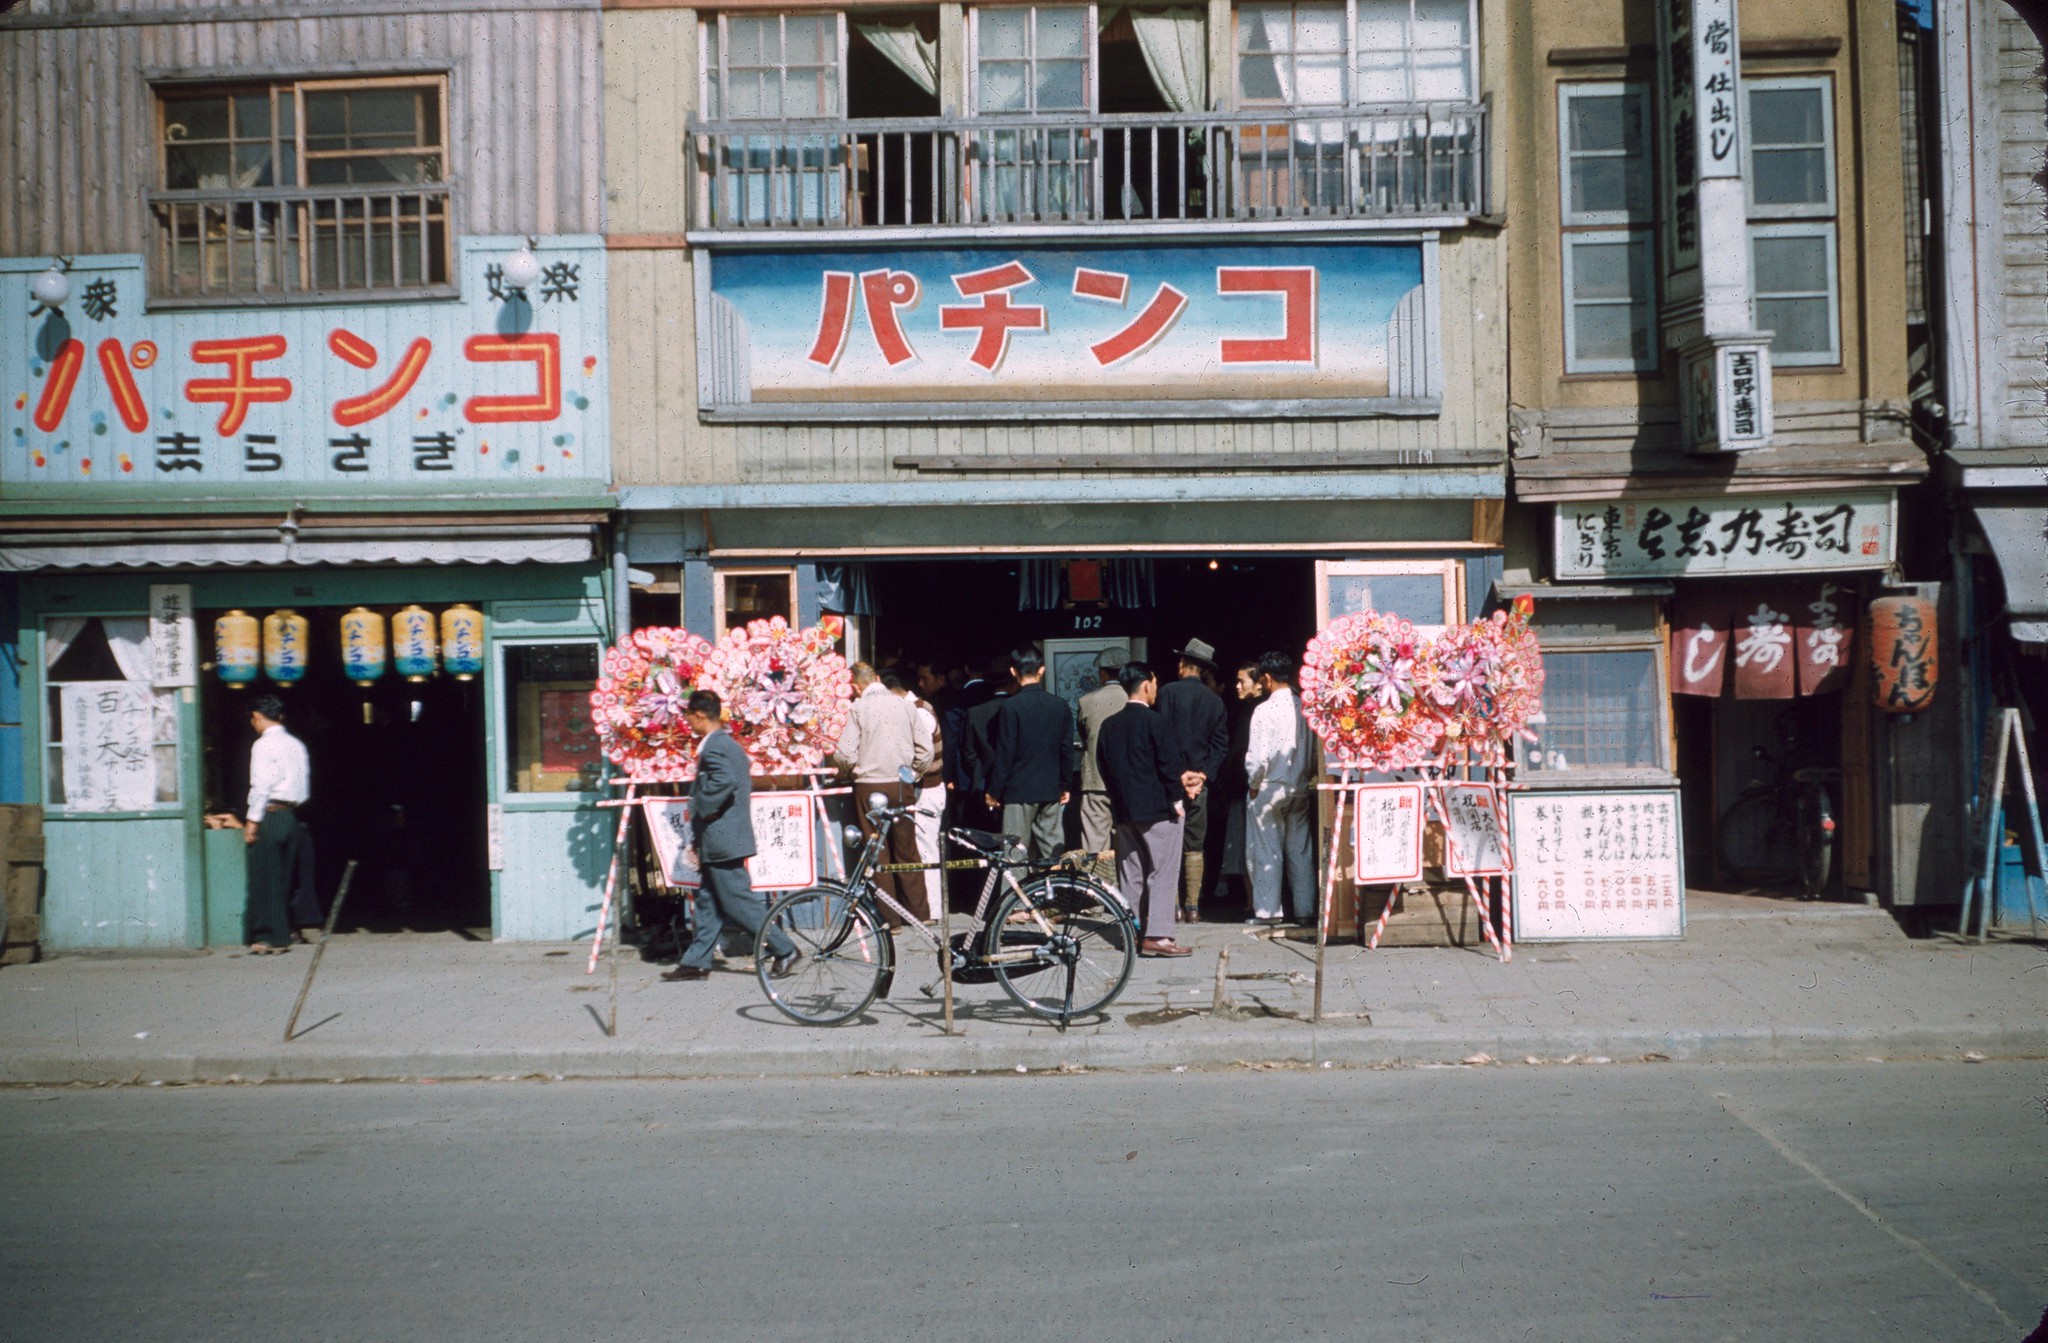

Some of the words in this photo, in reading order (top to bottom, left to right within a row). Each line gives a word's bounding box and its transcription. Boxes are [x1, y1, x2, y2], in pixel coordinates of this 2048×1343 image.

[808, 261, 1320, 374] パチンコ
[34, 328, 561, 438] パチンコ
[1602, 503, 1622, 559] 東京
[1074, 615, 1102, 629] 102
